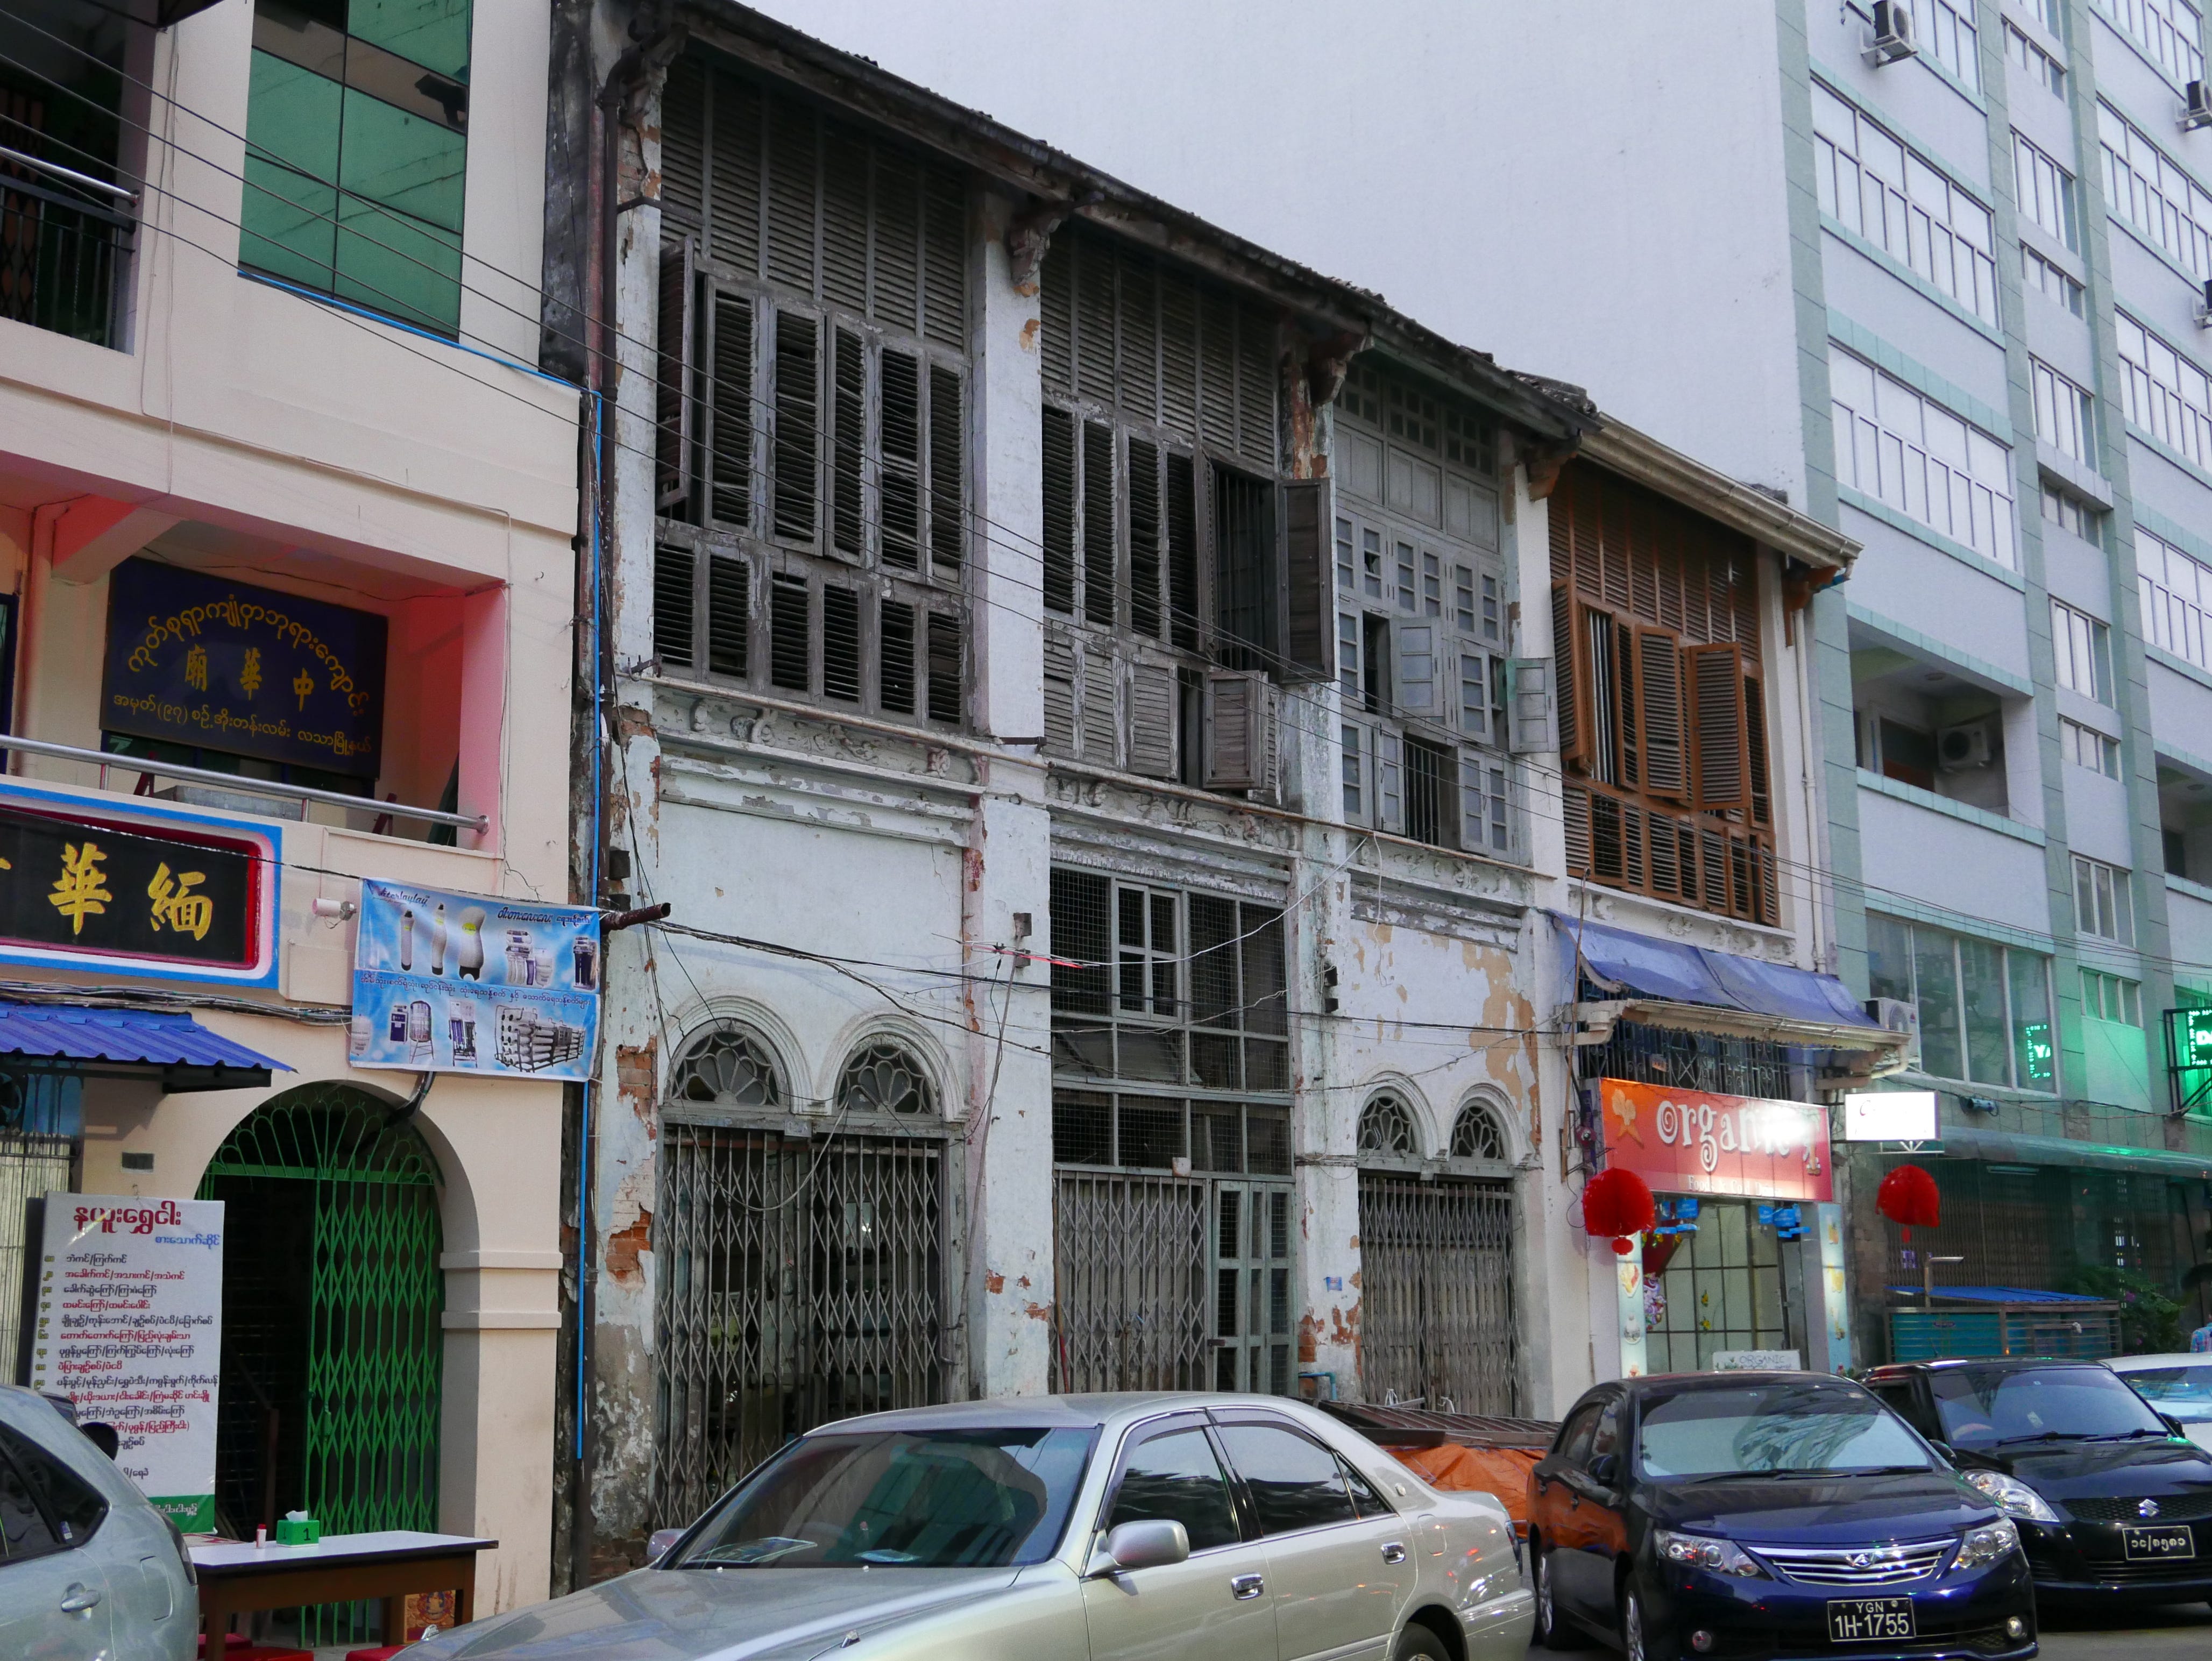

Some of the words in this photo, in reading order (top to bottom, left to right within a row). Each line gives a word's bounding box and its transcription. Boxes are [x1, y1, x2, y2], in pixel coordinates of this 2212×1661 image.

[1740, 1354, 1785, 1365] ORGANIC
[303, 1528, 311, 1541] 1
[1856, 1601, 1884, 1614] YGN
[1834, 1613, 1910, 1638] 1H-1755
